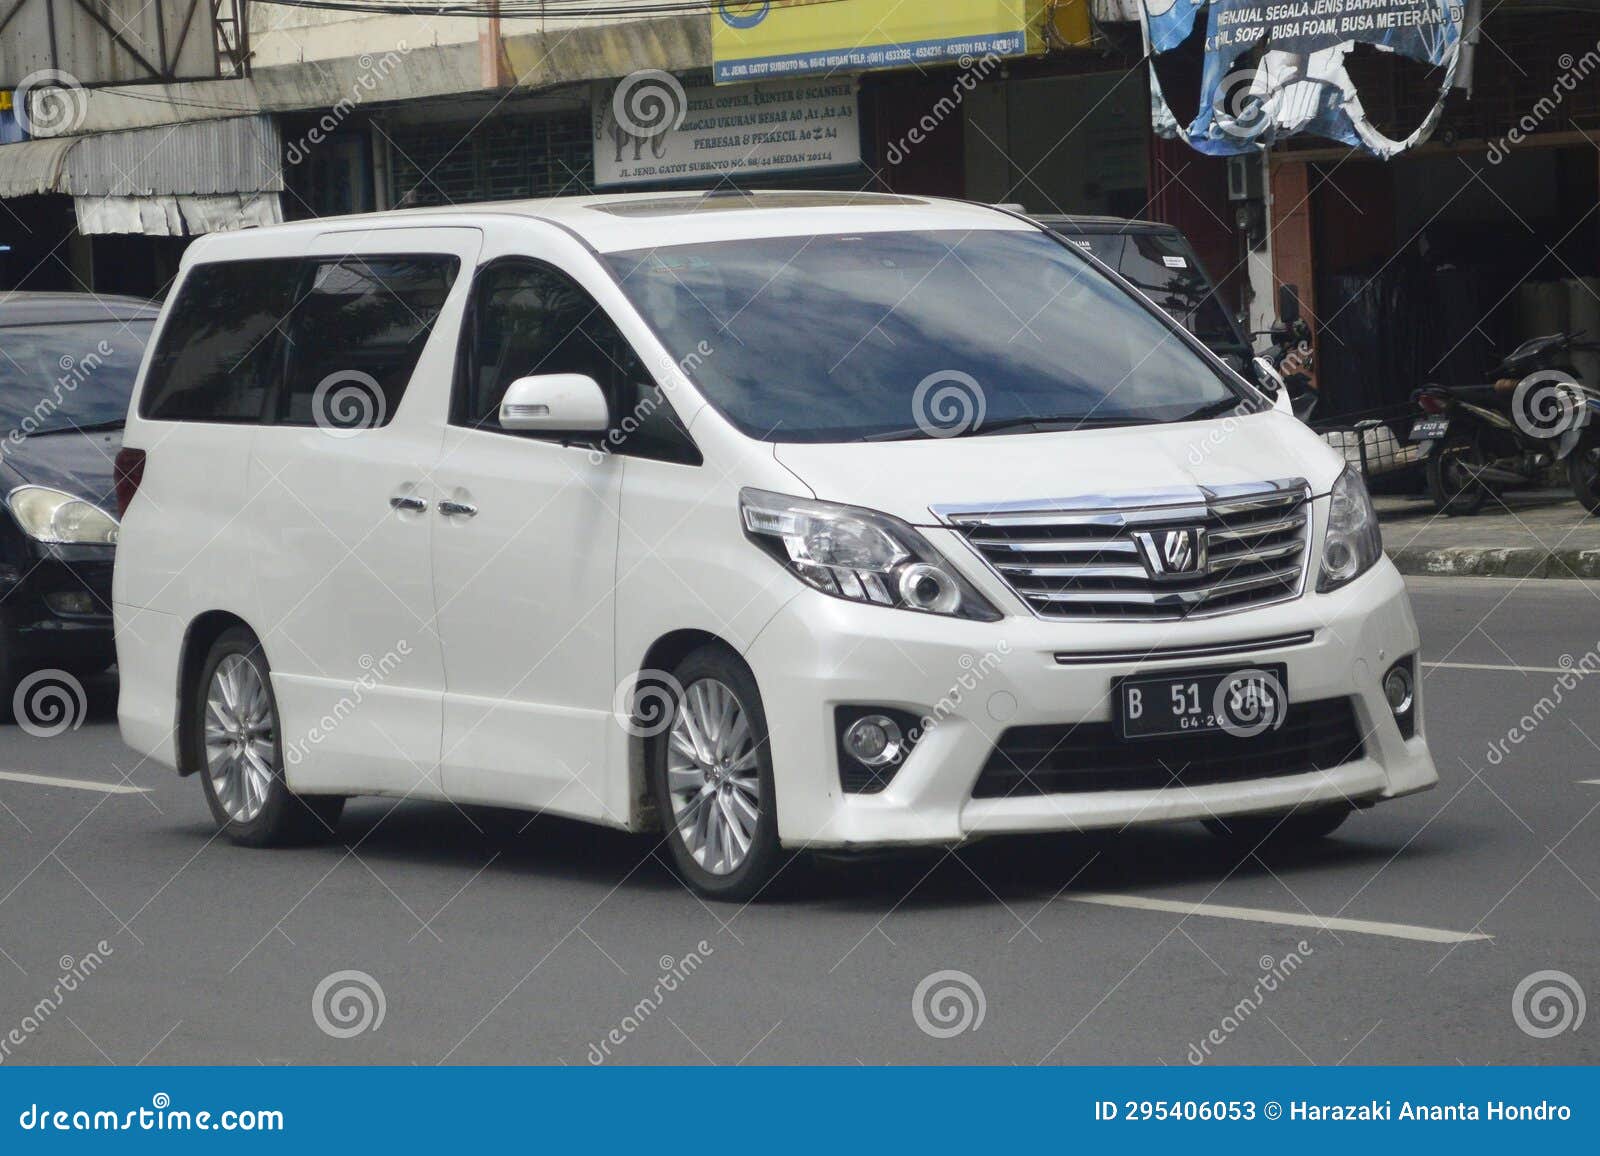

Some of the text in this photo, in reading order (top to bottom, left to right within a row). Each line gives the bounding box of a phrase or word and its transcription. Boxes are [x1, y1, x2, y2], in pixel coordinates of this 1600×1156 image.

[1217, 8, 1263, 26] MENJUAL
[1266, 2, 1309, 20] SEGALA
[1310, 0, 1344, 15] JENIS
[1272, 22, 1300, 40] BUSA
[1302, 18, 1338, 36] FOAM,
[1341, 14, 1374, 32] BUSA
[1376, 8, 1447, 29] METERAN,
[749, 62, 769, 74] GATOT
[769, 60, 799, 72] SUBROTO
[826, 54, 848, 66] MEDAN
[974, 41, 987, 53] FAX
[807, 85, 851, 98] SCANNER
[718, 114, 756, 128] UKURAN
[758, 110, 787, 124] BESAR
[694, 136, 740, 150] PERBESAR
[752, 129, 796, 144] PERKECIL
[633, 166, 657, 177] JEND.
[659, 163, 687, 174] GATOT
[689, 158, 729, 172] SUBROTO
[773, 153, 805, 165] MEDAN
[1128, 677, 1274, 719] B 51 SAL
